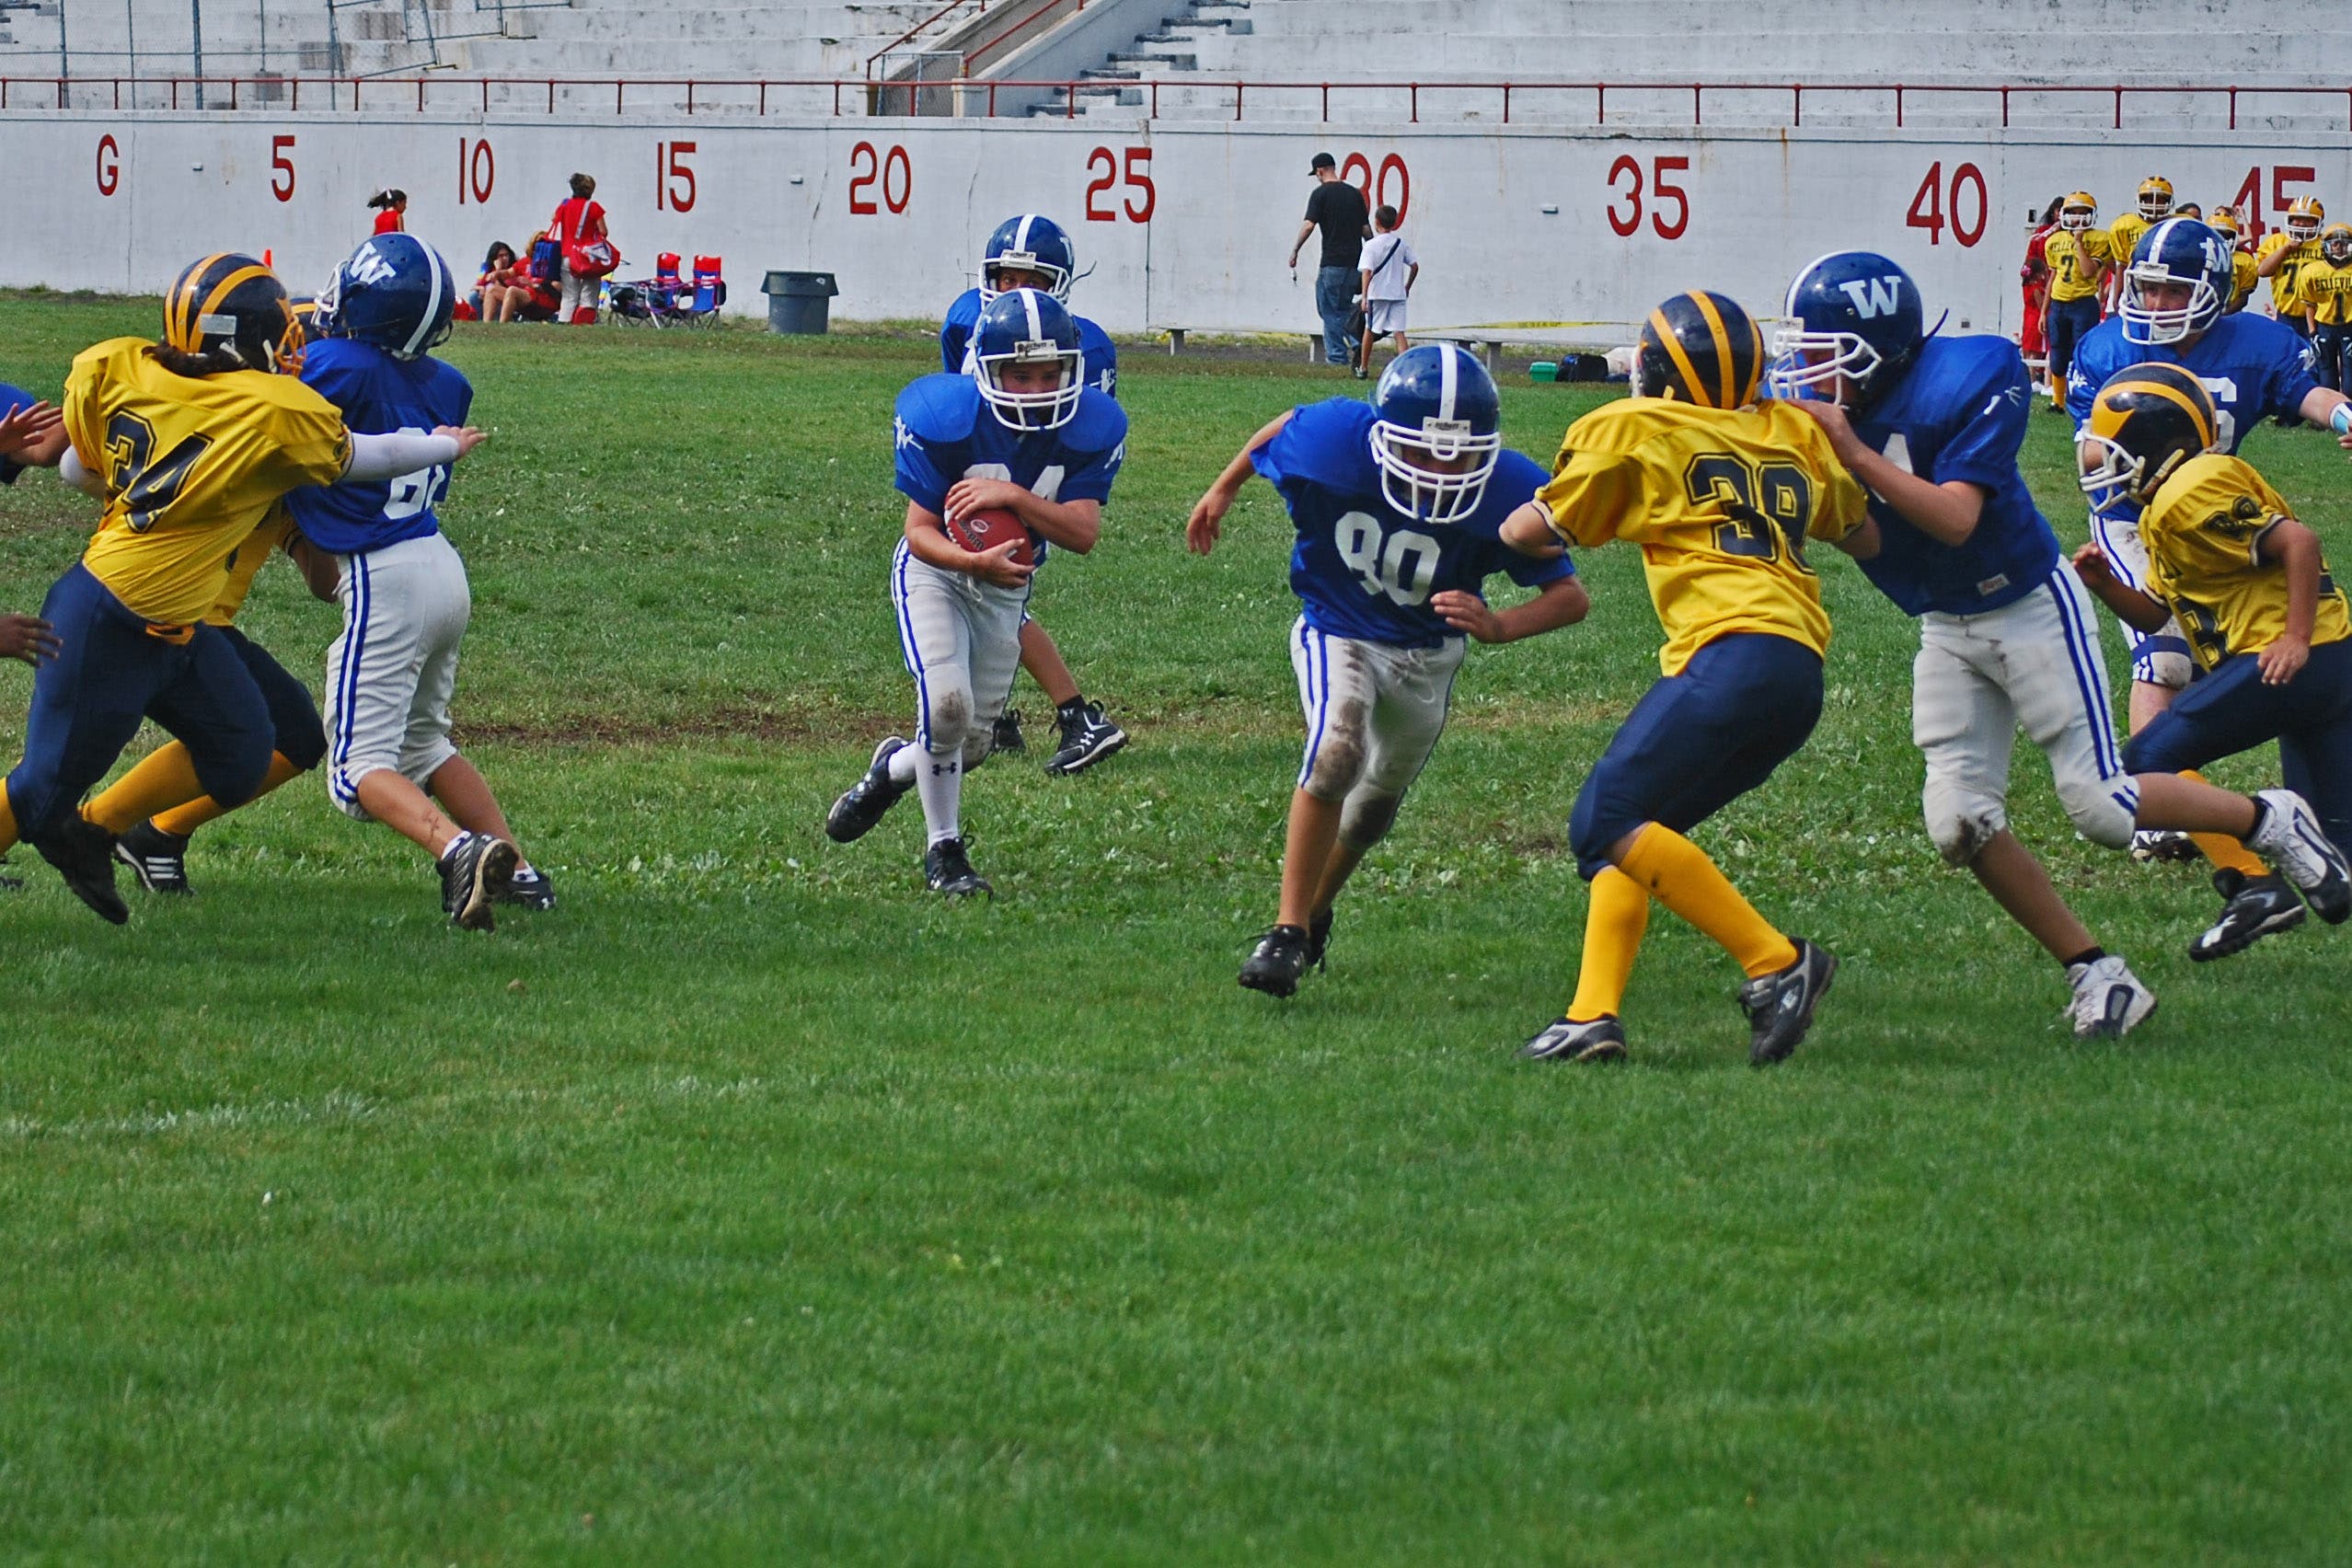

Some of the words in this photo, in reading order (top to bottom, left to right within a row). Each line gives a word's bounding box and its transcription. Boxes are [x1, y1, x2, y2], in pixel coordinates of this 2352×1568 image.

[97, 134, 120, 197] G
[272, 135, 295, 202] 5
[458, 137, 494, 205] 10
[657, 142, 697, 213] 15
[849, 142, 912, 215] 20
[1086, 146, 1156, 224] 25
[1607, 154, 1689, 240] 35
[1906, 161, 1988, 248] 40
[349, 241, 397, 286] W
[2199, 236, 2231, 272] W
[1839, 275, 1902, 319] W
[2333, 292, 2346, 324] 1
